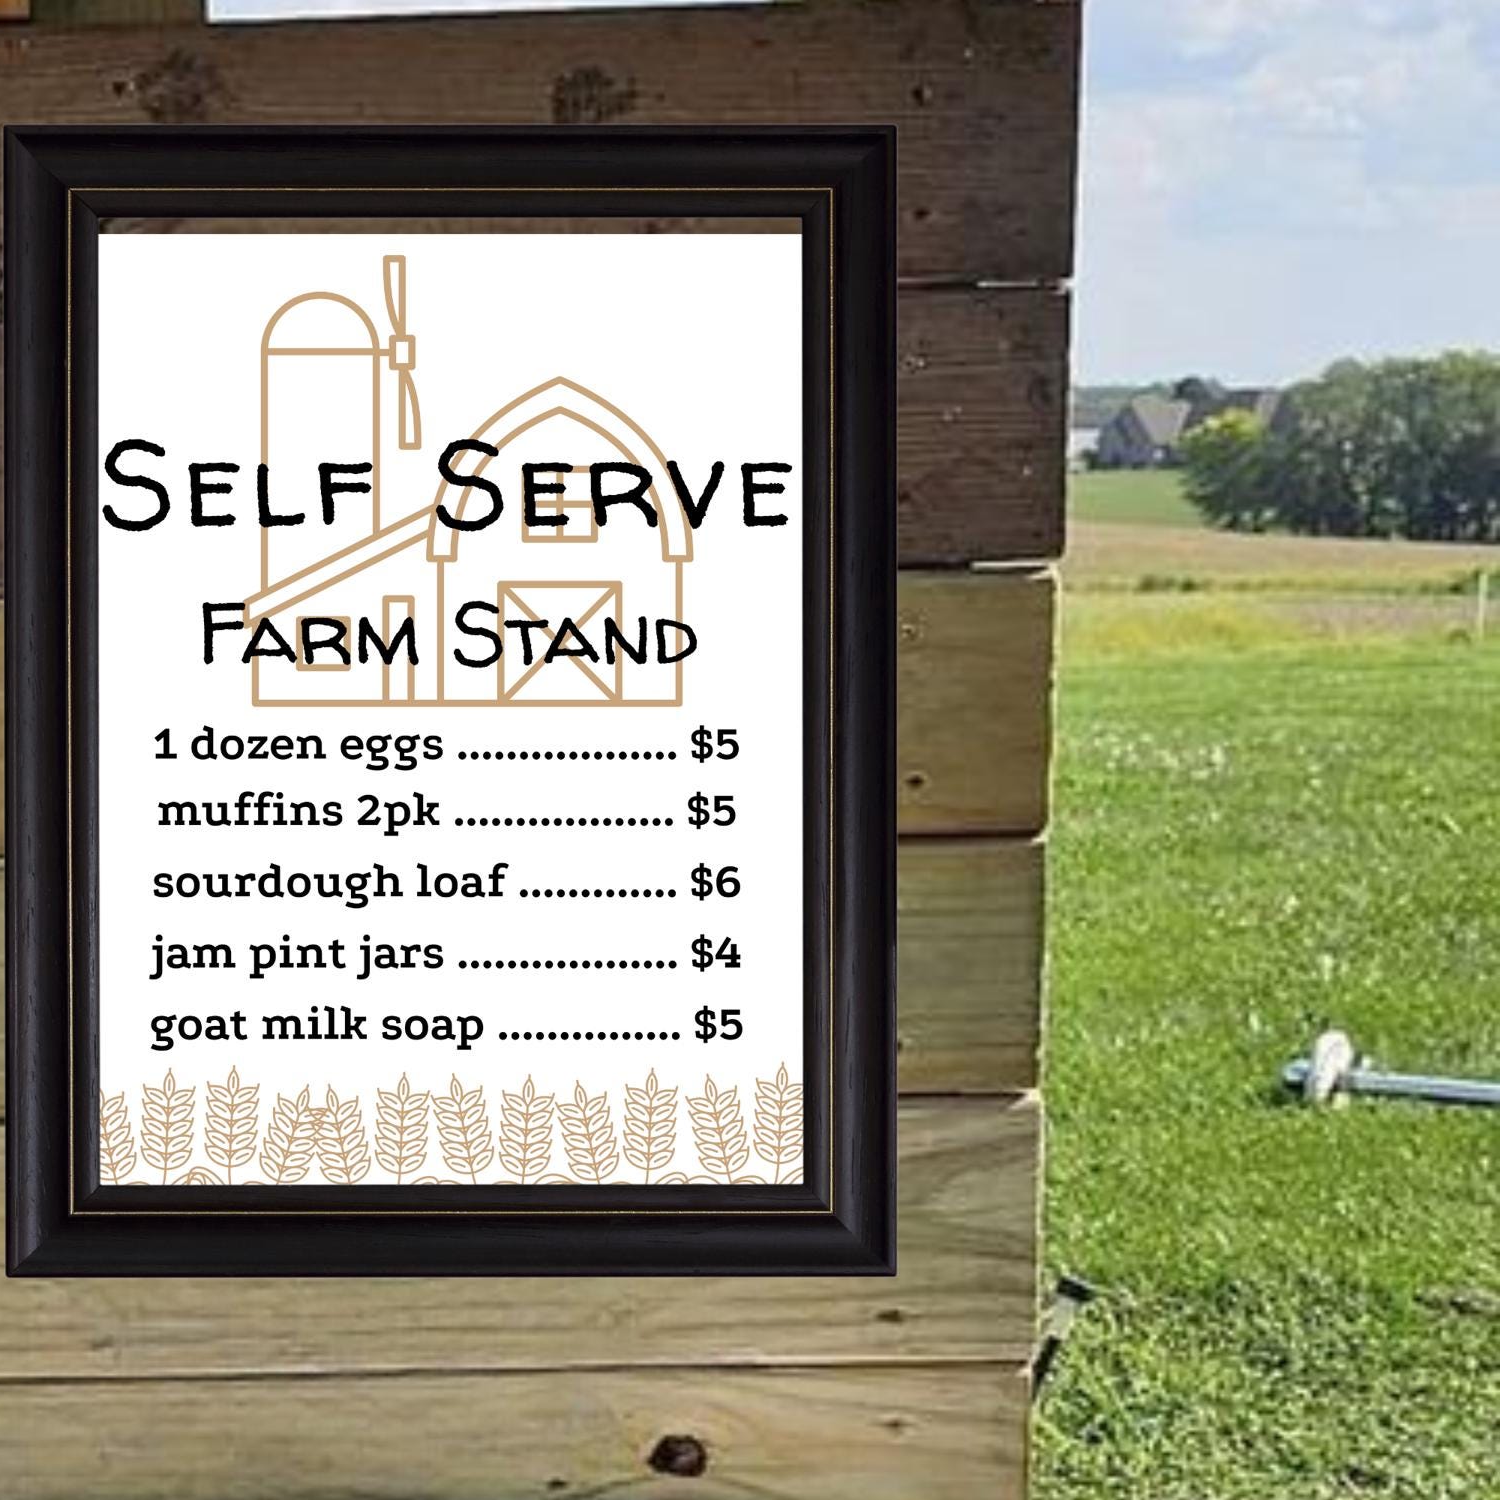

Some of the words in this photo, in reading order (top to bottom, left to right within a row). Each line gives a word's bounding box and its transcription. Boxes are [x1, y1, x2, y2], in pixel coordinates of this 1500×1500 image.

[155, 729, 177, 759] 1
[191, 726, 326, 760] dozen
[341, 735, 443, 770] eggs
[691, 725, 739, 763] $5
[158, 791, 342, 826] muffins
[358, 792, 439, 836] 2pk
[688, 792, 735, 829] $5
[154, 863, 403, 908] sourdough
[417, 863, 509, 897] loaf
[691, 863, 740, 901] $6
[149, 935, 235, 979] jam
[250, 935, 346, 978] pint
[357, 935, 443, 979] jars
[692, 934, 740, 972] $4
[151, 1011, 247, 1051] goat
[262, 1006, 367, 1039] milk
[382, 1016, 483, 1050] soap
[695, 1006, 742, 1043] $5
